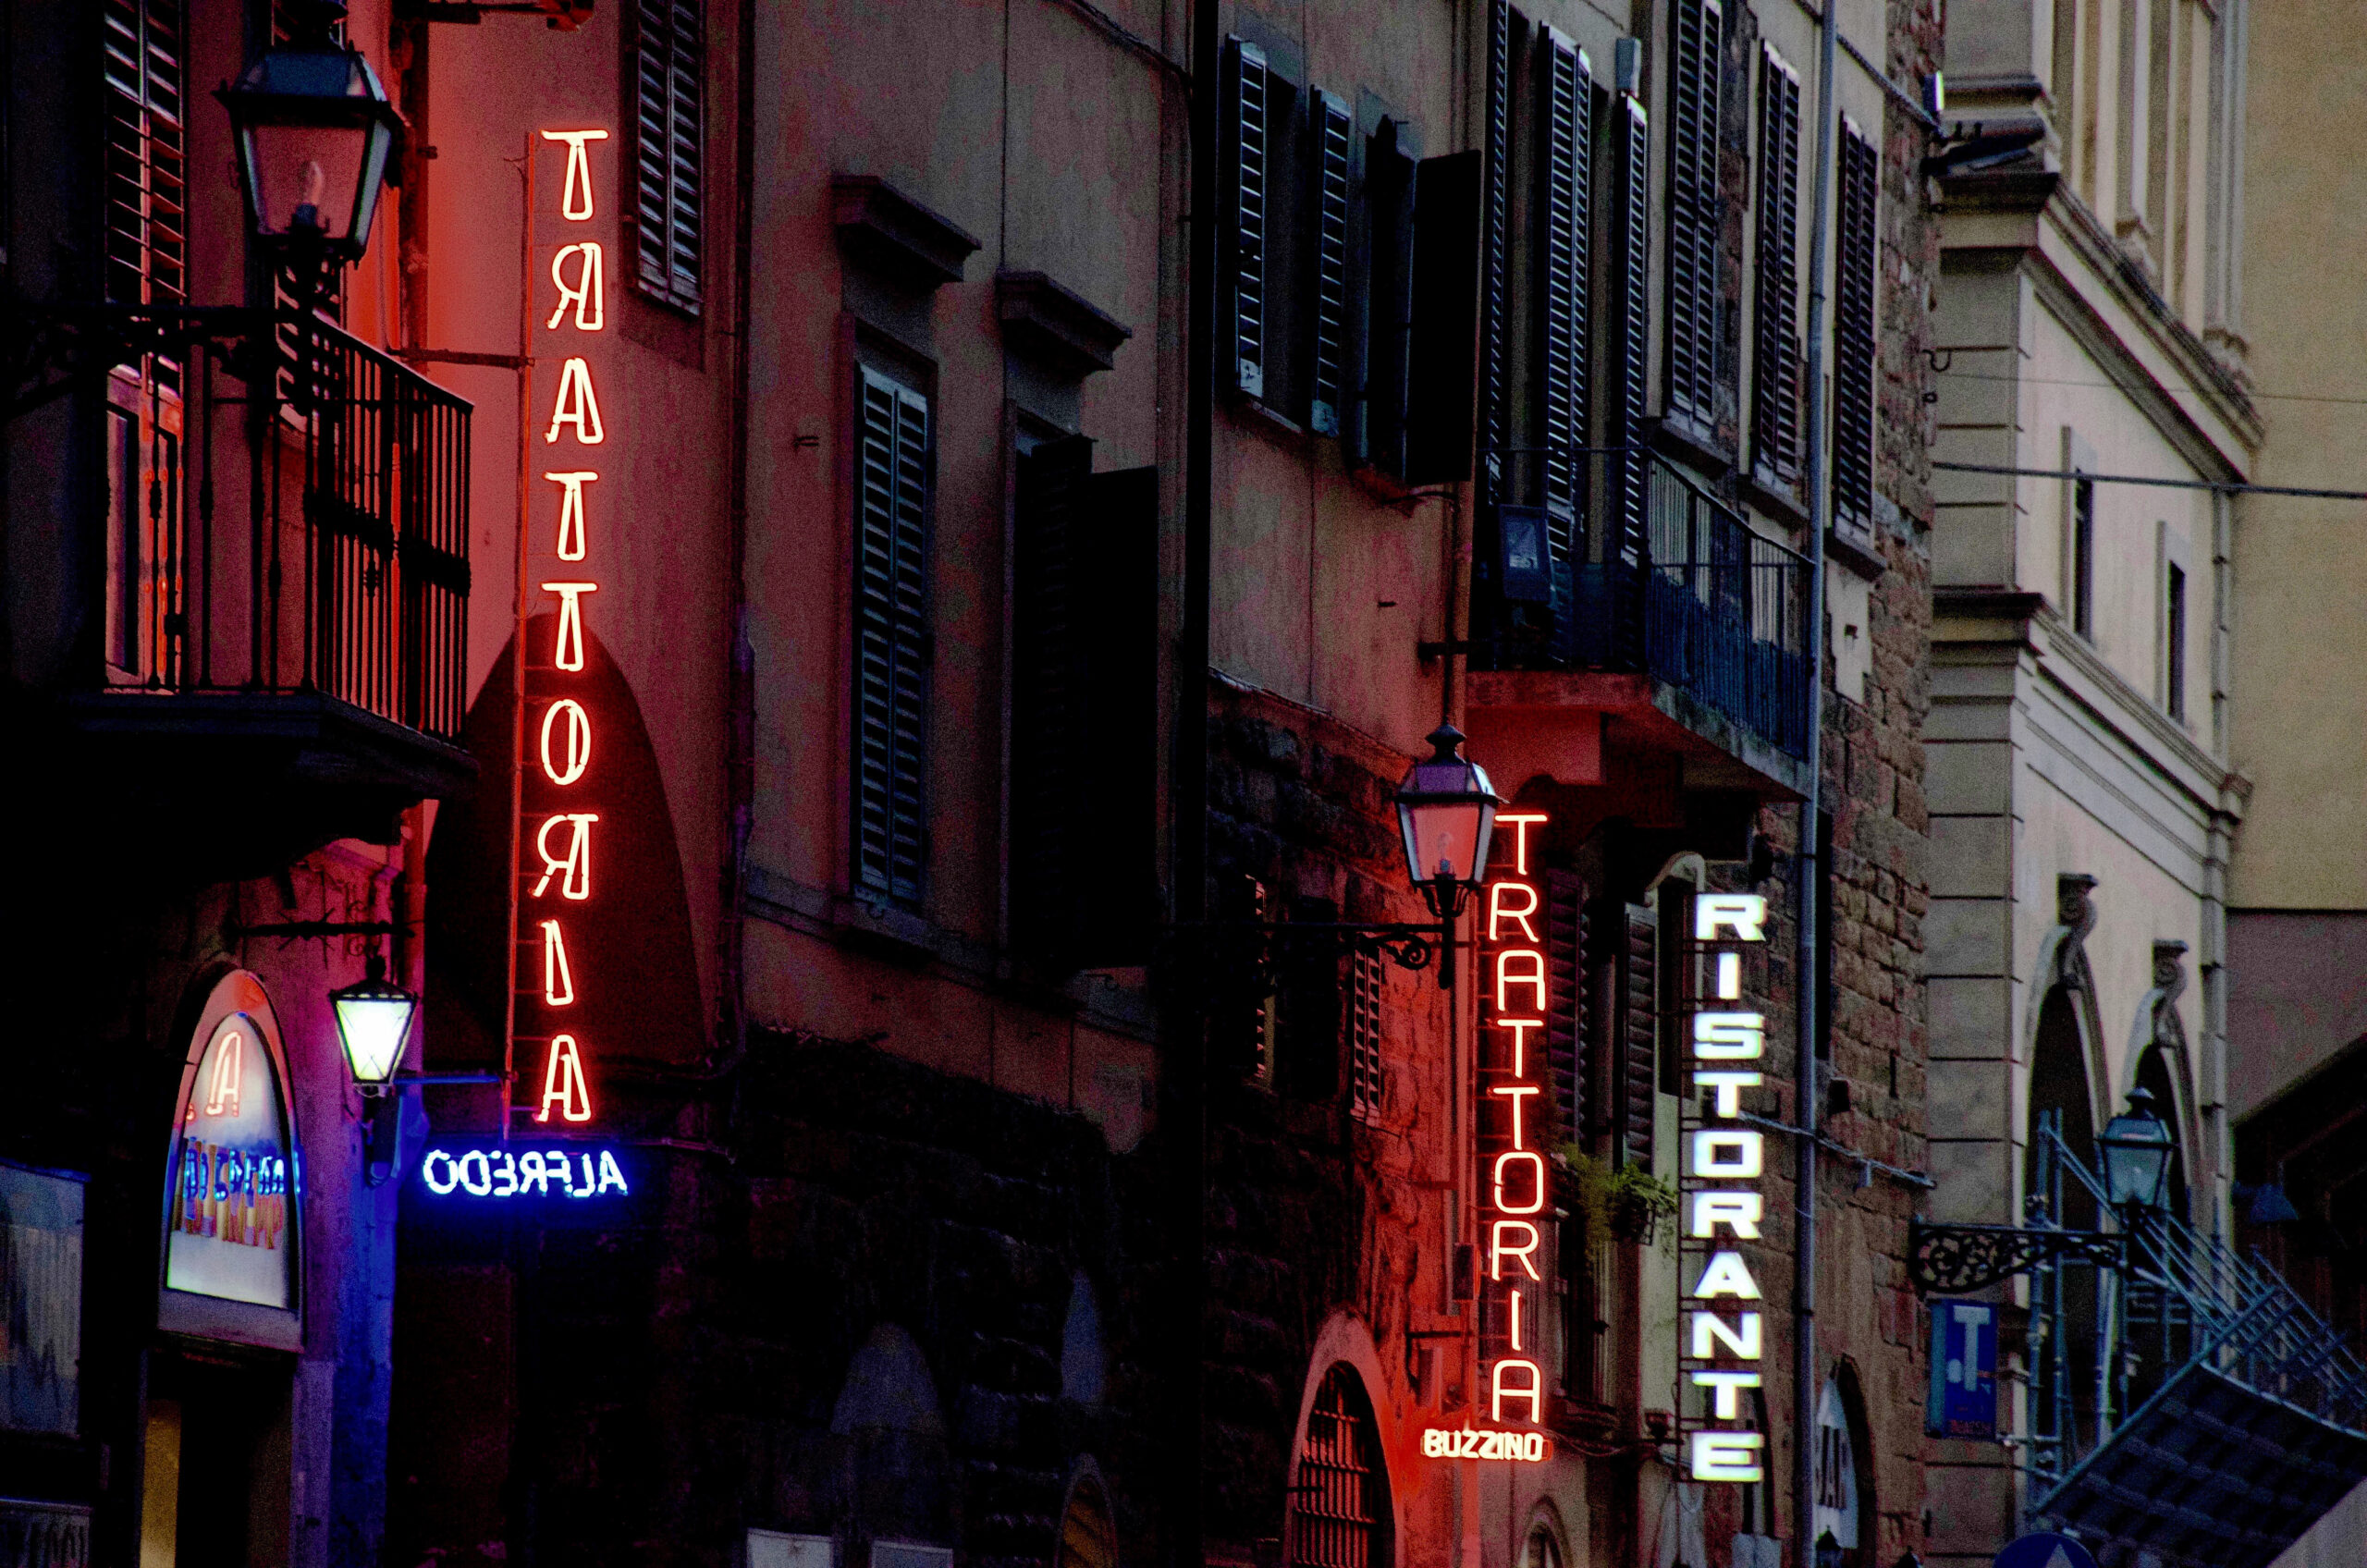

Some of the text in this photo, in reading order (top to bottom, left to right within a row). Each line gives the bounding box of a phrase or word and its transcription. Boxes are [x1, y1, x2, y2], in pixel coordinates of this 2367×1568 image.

[1489, 814, 1548, 1424] TRATTORIA
[1691, 893, 1767, 1482] RISTORANTE
[1423, 1429, 1545, 1462] BUZZINO
